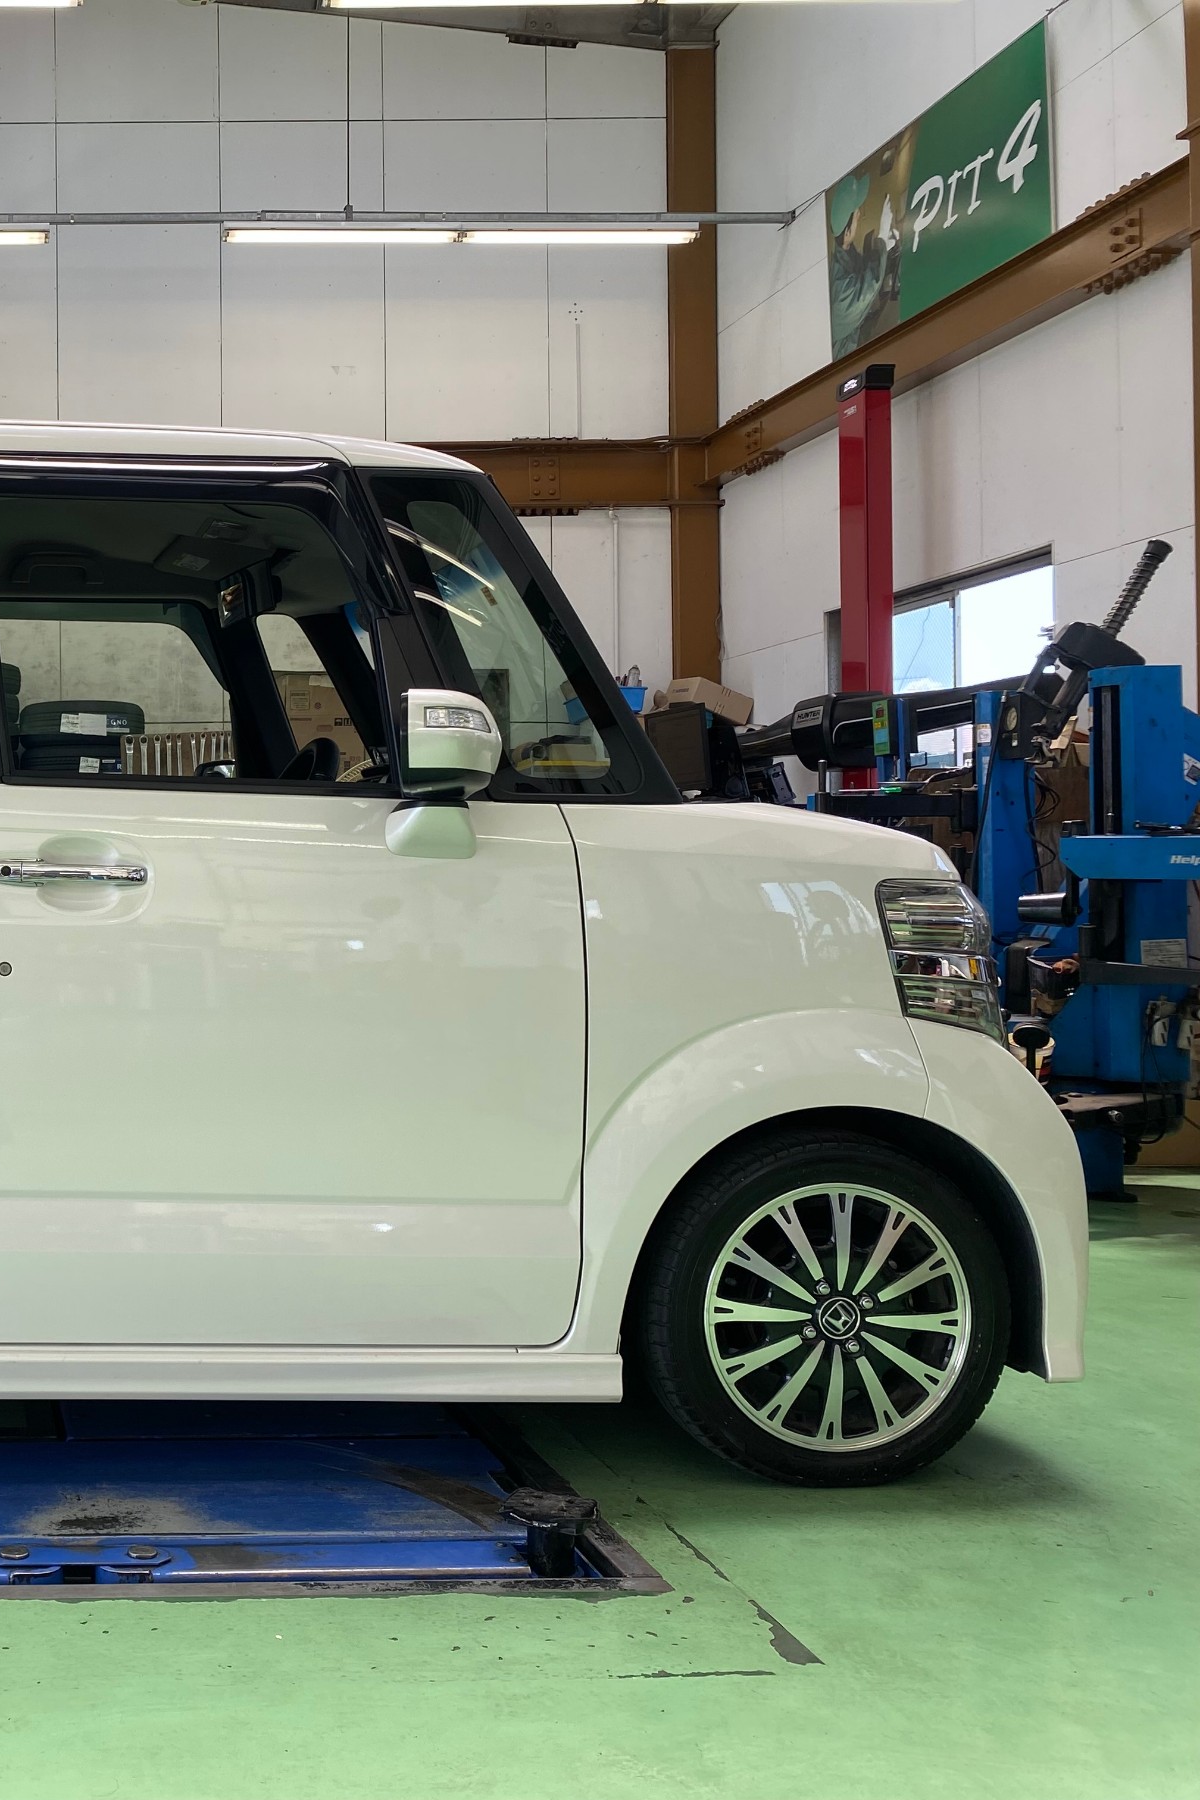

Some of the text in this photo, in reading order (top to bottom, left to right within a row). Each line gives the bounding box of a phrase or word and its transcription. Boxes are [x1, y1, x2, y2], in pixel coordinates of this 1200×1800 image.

[910, 99, 1042, 253] PIT 4
[797, 709, 822, 721] HUNTER
